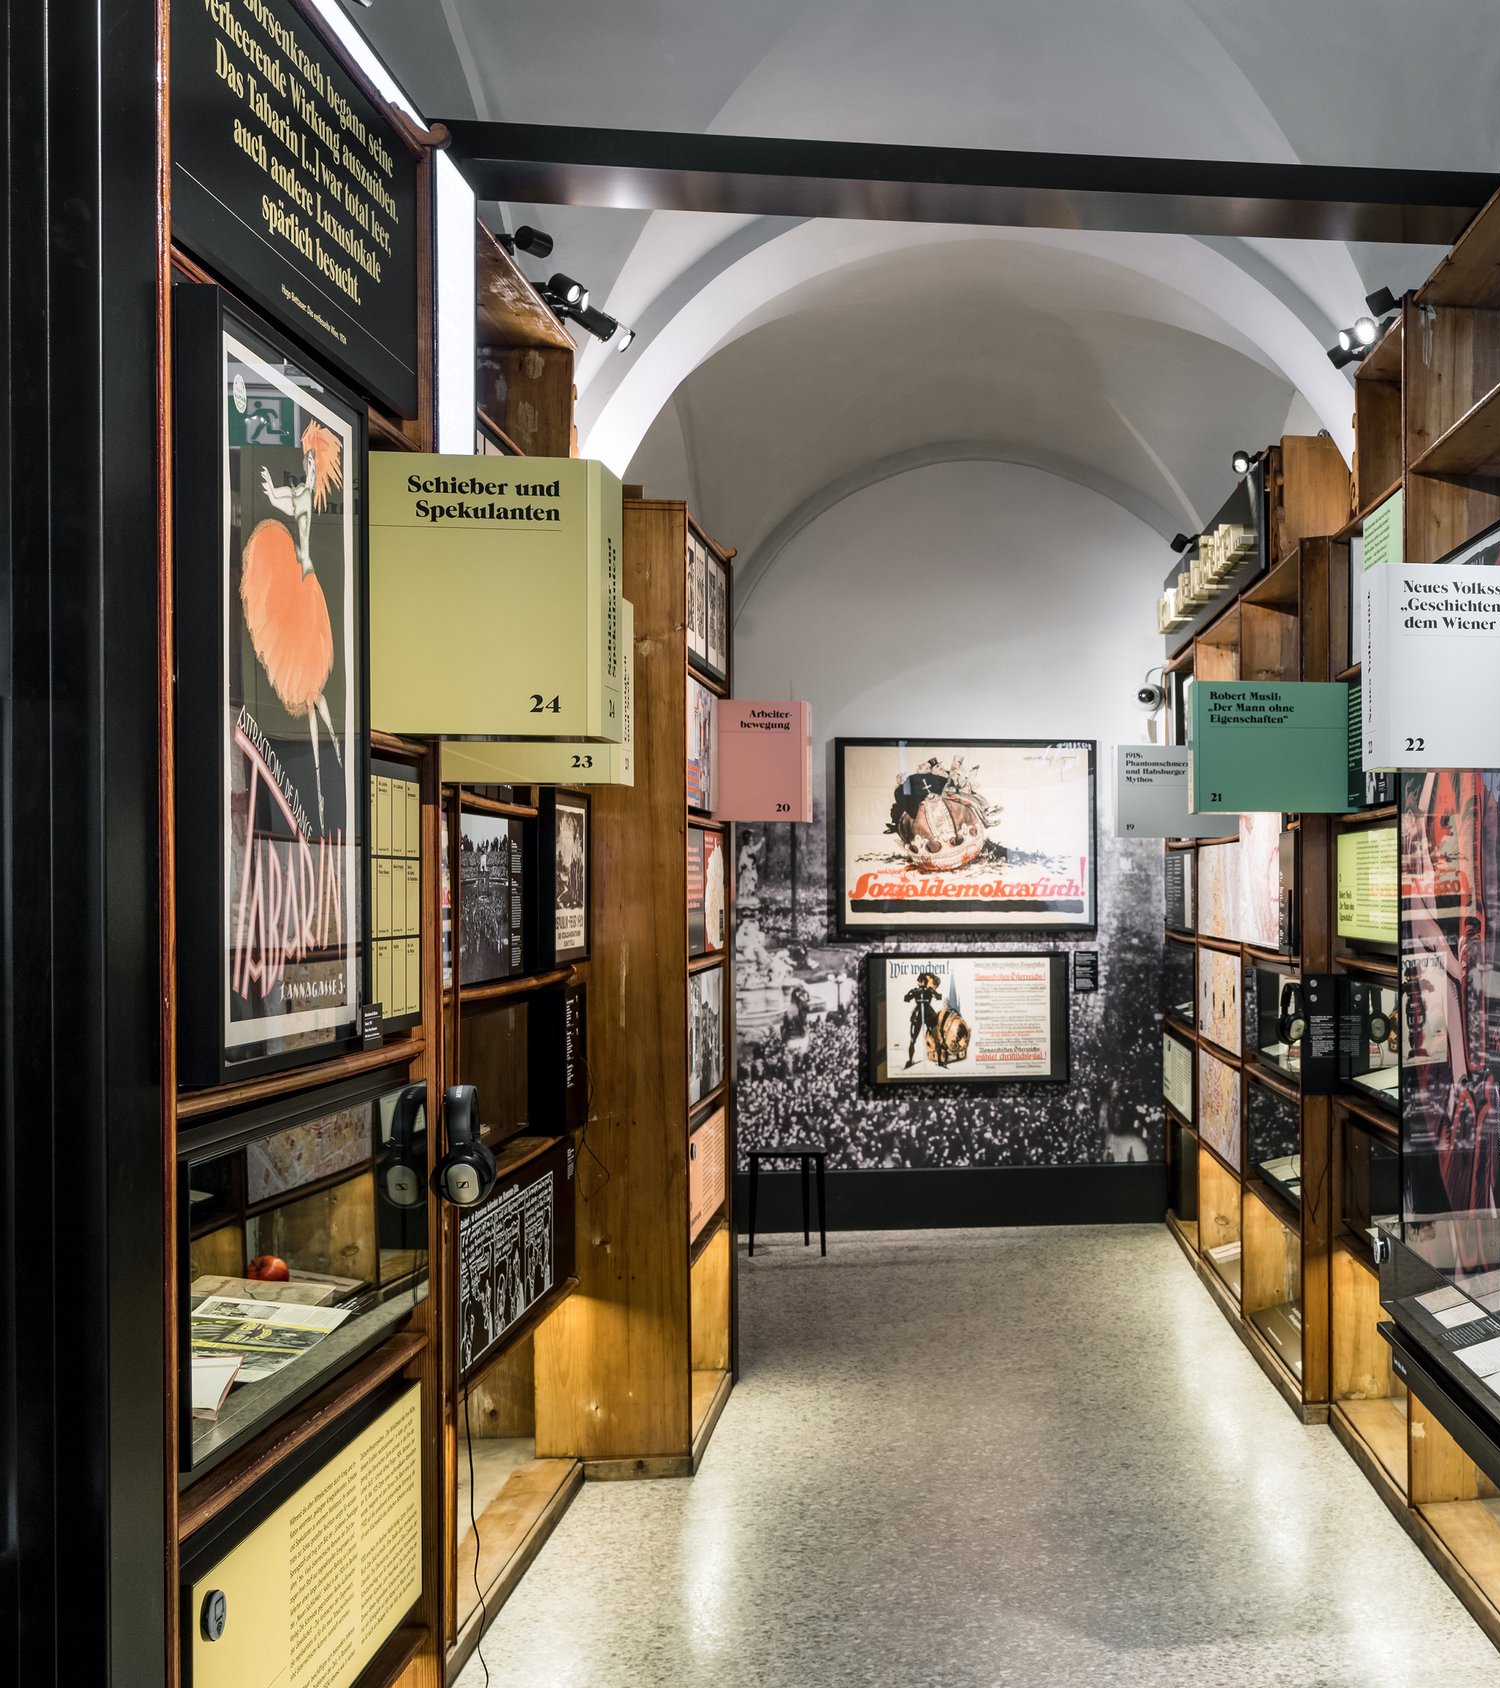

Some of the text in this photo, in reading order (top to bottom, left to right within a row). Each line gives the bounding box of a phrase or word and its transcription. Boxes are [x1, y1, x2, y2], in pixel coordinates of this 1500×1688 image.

[327, 76, 366, 147] begann
[368, 134, 393, 178] seine
[215, 38, 244, 99] Das
[247, 73, 299, 158] Tabarin
[321, 161, 342, 202] war
[345, 183, 368, 232] total
[371, 211, 391, 258] leer,
[289, 73, 340, 165] Wirkung
[343, 144, 398, 224] auszuüben.
[234, 118, 381, 283] auch andere Luxuslokale
[262, 195, 361, 306] spärlich besucht.
[407, 474, 560, 497] Schieber und
[415, 500, 560, 522] Spekulanten
[1403, 580, 1448, 594] Neues
[1401, 598, 1500, 613] „Geschichten
[1404, 617, 1437, 629] dem
[1442, 617, 1496, 630] Wiener
[530, 694, 561, 713] 24
[1210, 692, 1281, 700] Robert Musil:
[749, 710, 792, 718] Arbeiter-
[1208, 703, 1294, 712] „Der Mann ohne
[740, 721, 790, 730] bewegung
[1210, 714, 1288, 724] Eigenschaften“
[1405, 738, 1425, 752] 22
[571, 755, 593, 768] 23
[236, 705, 313, 848] ATTRACTIONS DE DANCE
[1211, 793, 1222, 801] 21
[776, 804, 790, 812] 20
[232, 725, 343, 999] TABARIN
[890, 960, 949, 978] Wir wachen!
